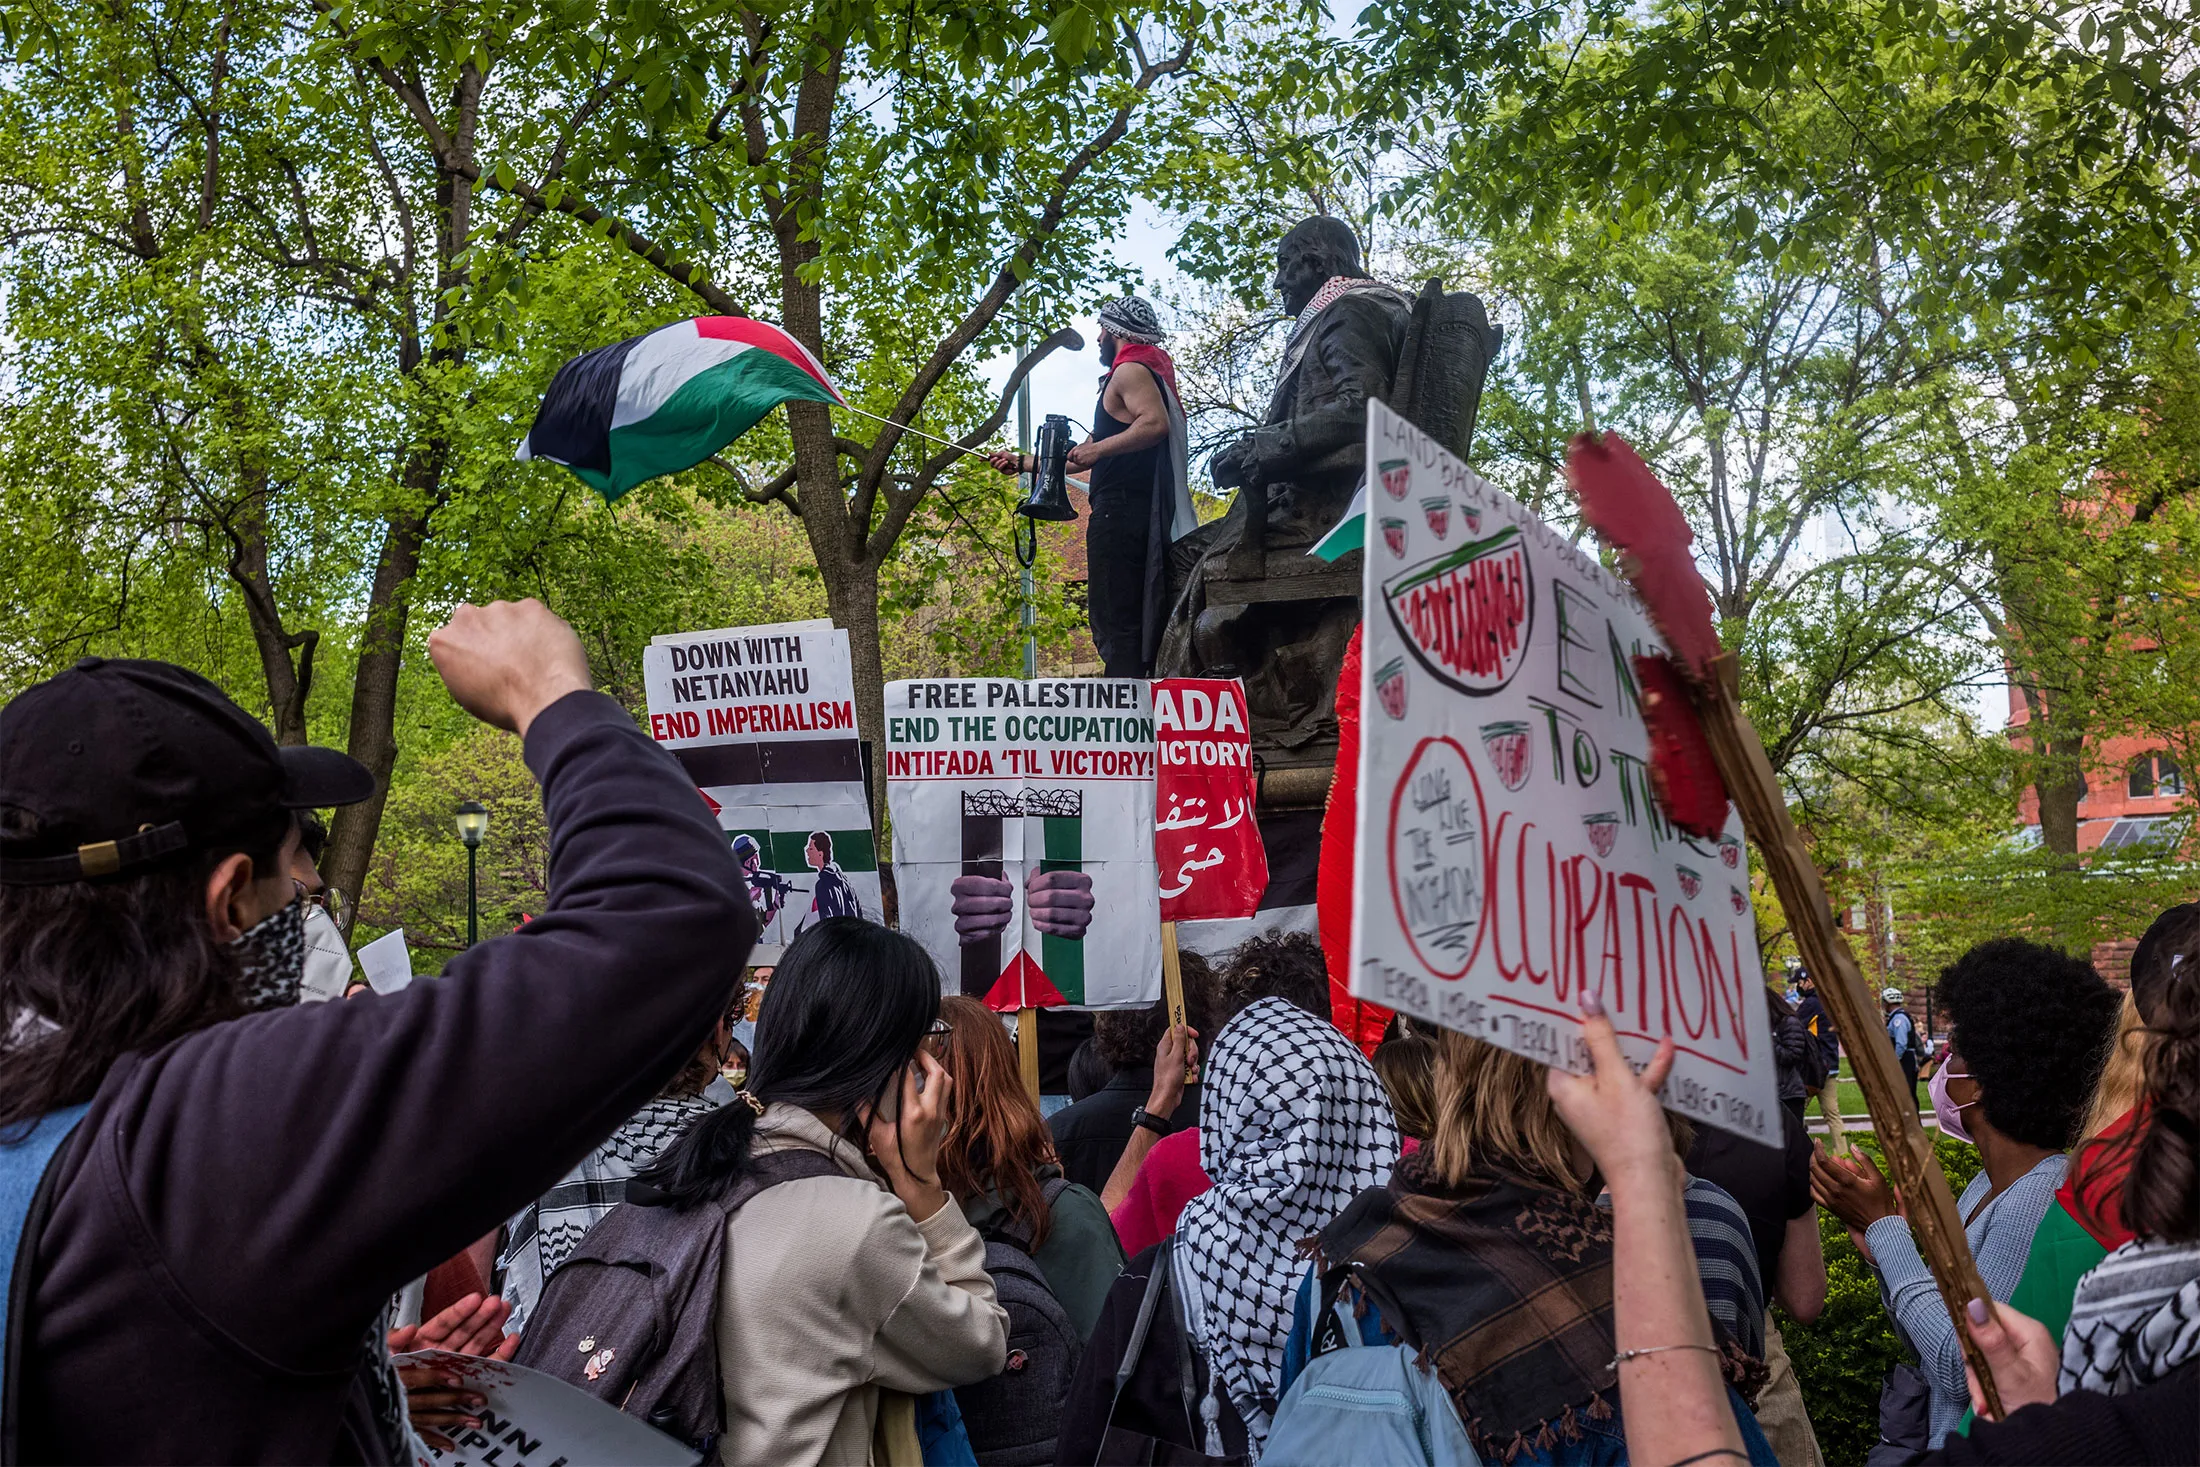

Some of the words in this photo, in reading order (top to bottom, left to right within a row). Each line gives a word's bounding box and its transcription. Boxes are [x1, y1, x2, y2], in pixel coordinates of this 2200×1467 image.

[671, 640, 742, 672] DOWN
[744, 636, 803, 665] WITH
[1553, 578, 1672, 719] EN
[672, 667, 809, 703] NETANYAHU
[908, 683, 977, 709] FREE
[988, 683, 1138, 709] PALESTINE!
[651, 711, 700, 741] END
[706, 700, 853, 736] IMPERIALISM
[890, 717, 939, 743] END
[952, 717, 997, 742] THE
[1005, 715, 1154, 743] OCCUPATION
[1155, 690, 1246, 733] ADA
[1157, 740, 1250, 768] ICTORY
[1528, 696, 1600, 788] TO
[888, 750, 994, 777] INTIFADA
[1050, 750, 1154, 777] VICTORY!
